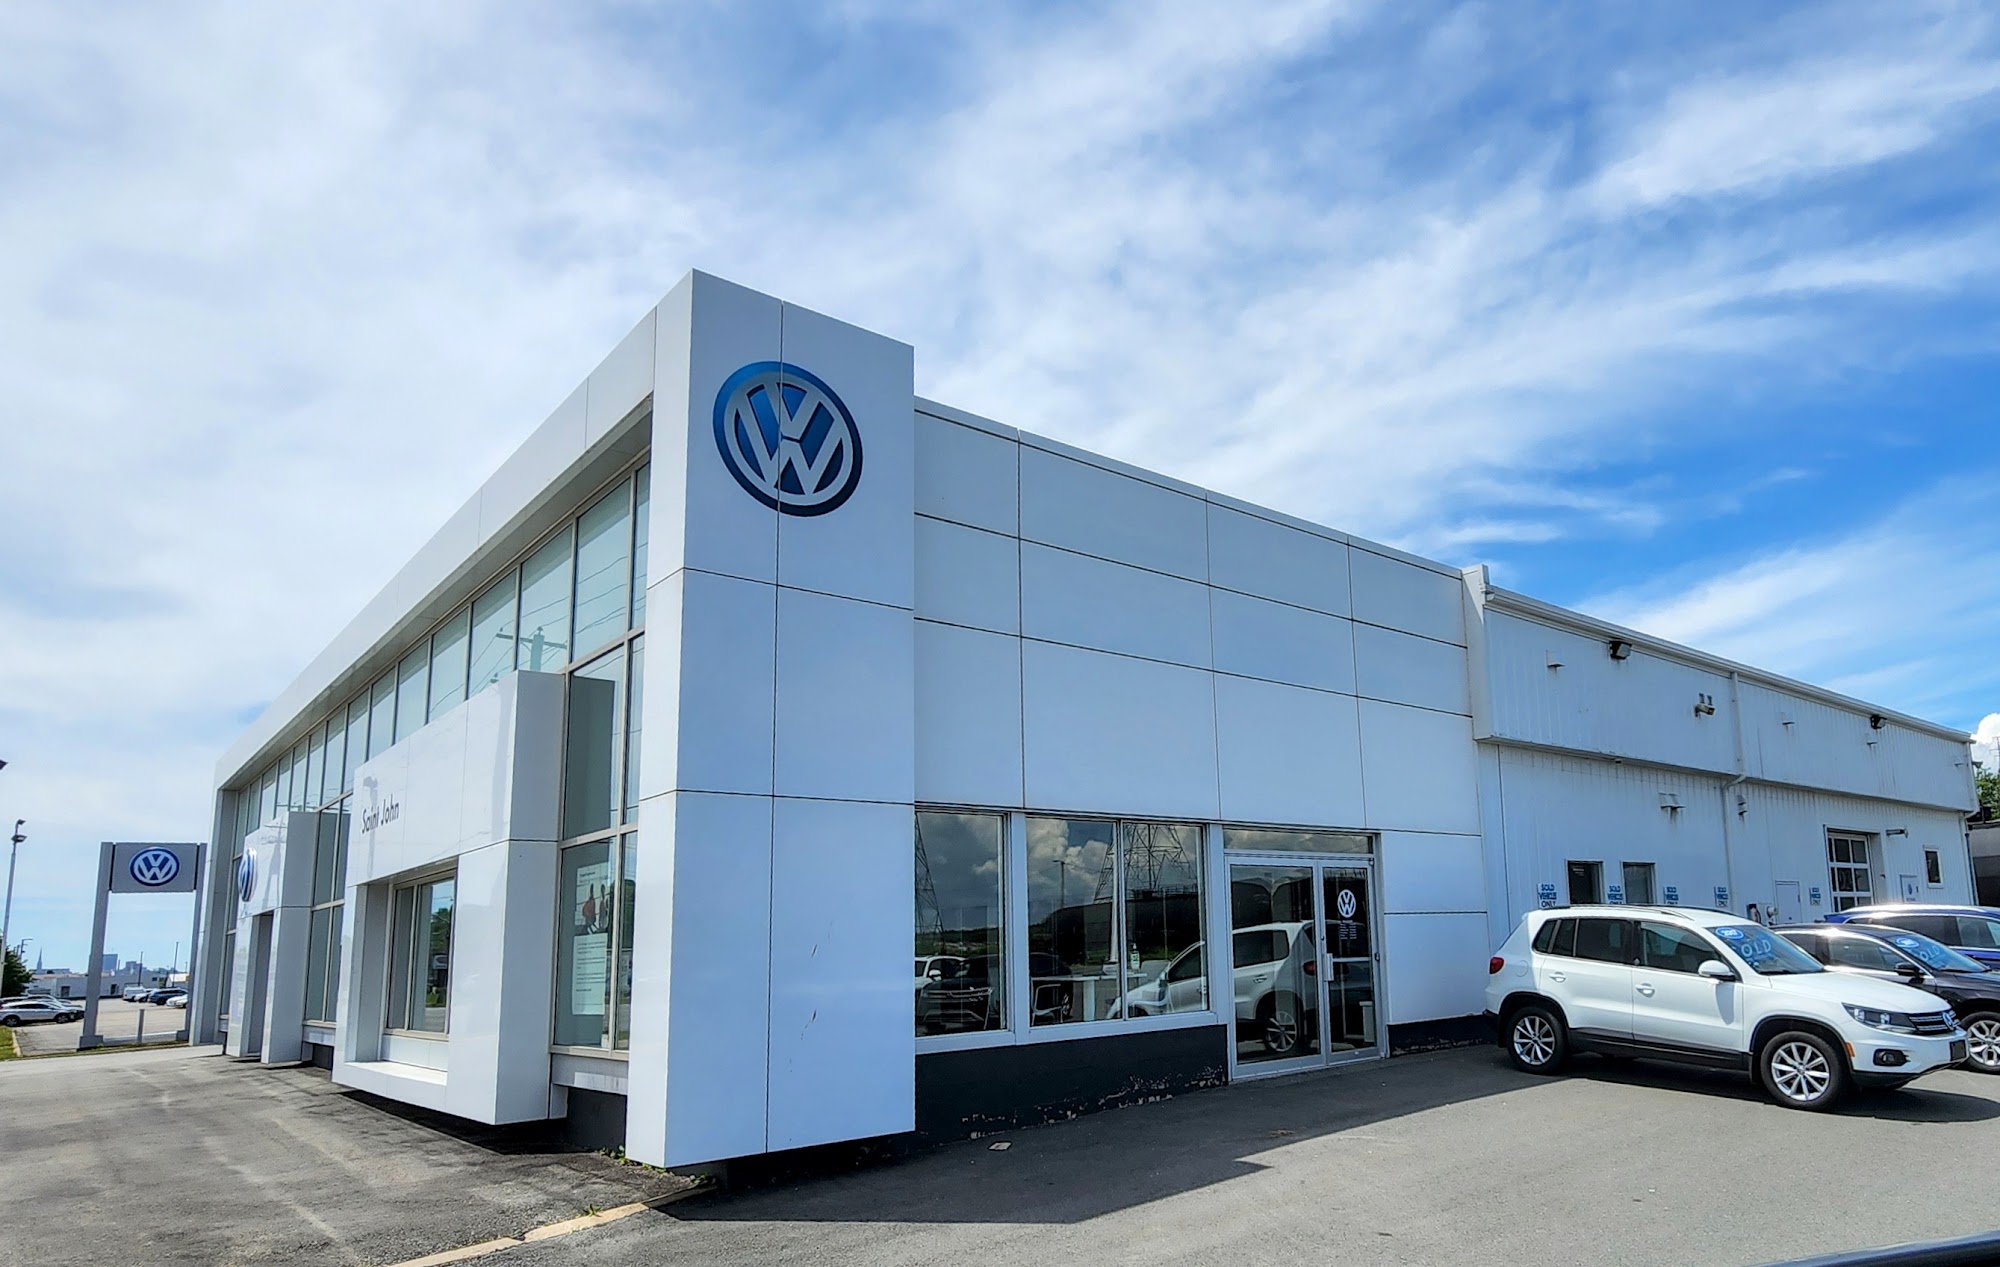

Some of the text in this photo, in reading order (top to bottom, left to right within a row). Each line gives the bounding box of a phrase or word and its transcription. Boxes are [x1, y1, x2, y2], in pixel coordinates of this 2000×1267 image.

[723, 370, 854, 507] VW
[362, 793, 400, 834] Saint John
[133, 849, 178, 884] VW
